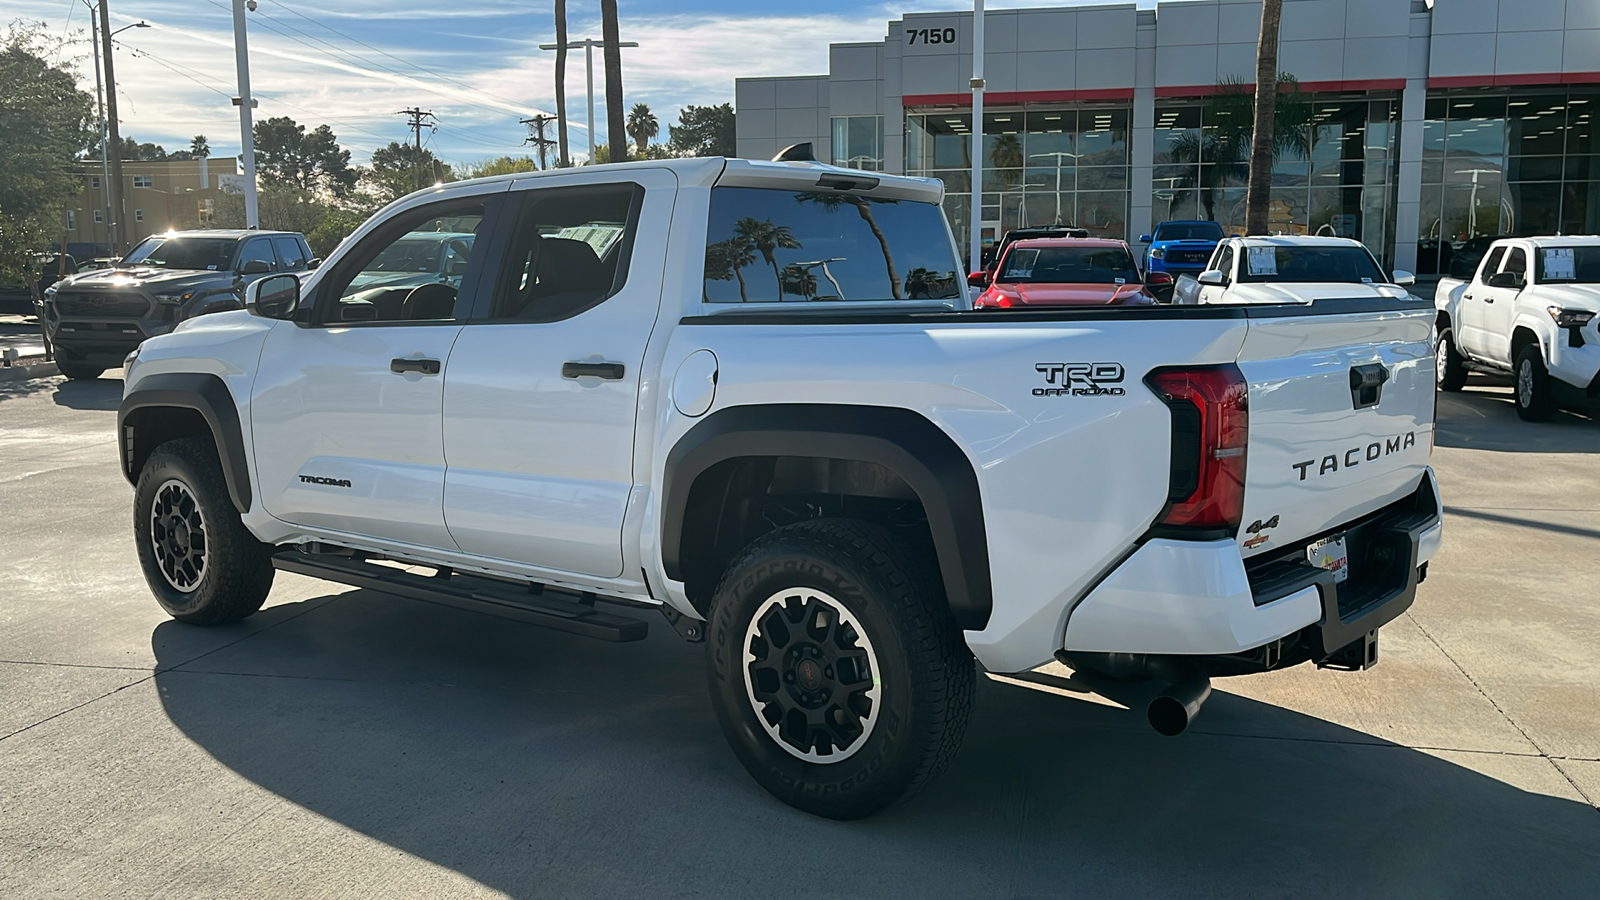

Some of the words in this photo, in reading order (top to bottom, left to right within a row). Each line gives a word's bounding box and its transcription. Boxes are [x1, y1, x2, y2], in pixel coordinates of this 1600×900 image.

[906, 27, 956, 45] 7150
[1035, 362, 1125, 389] TRD
[1032, 388, 1070, 396] OFF
[1072, 387, 1126, 396] ROAD
[1292, 431, 1415, 481] TACOMA
[298, 474, 352, 488] TACOMA
